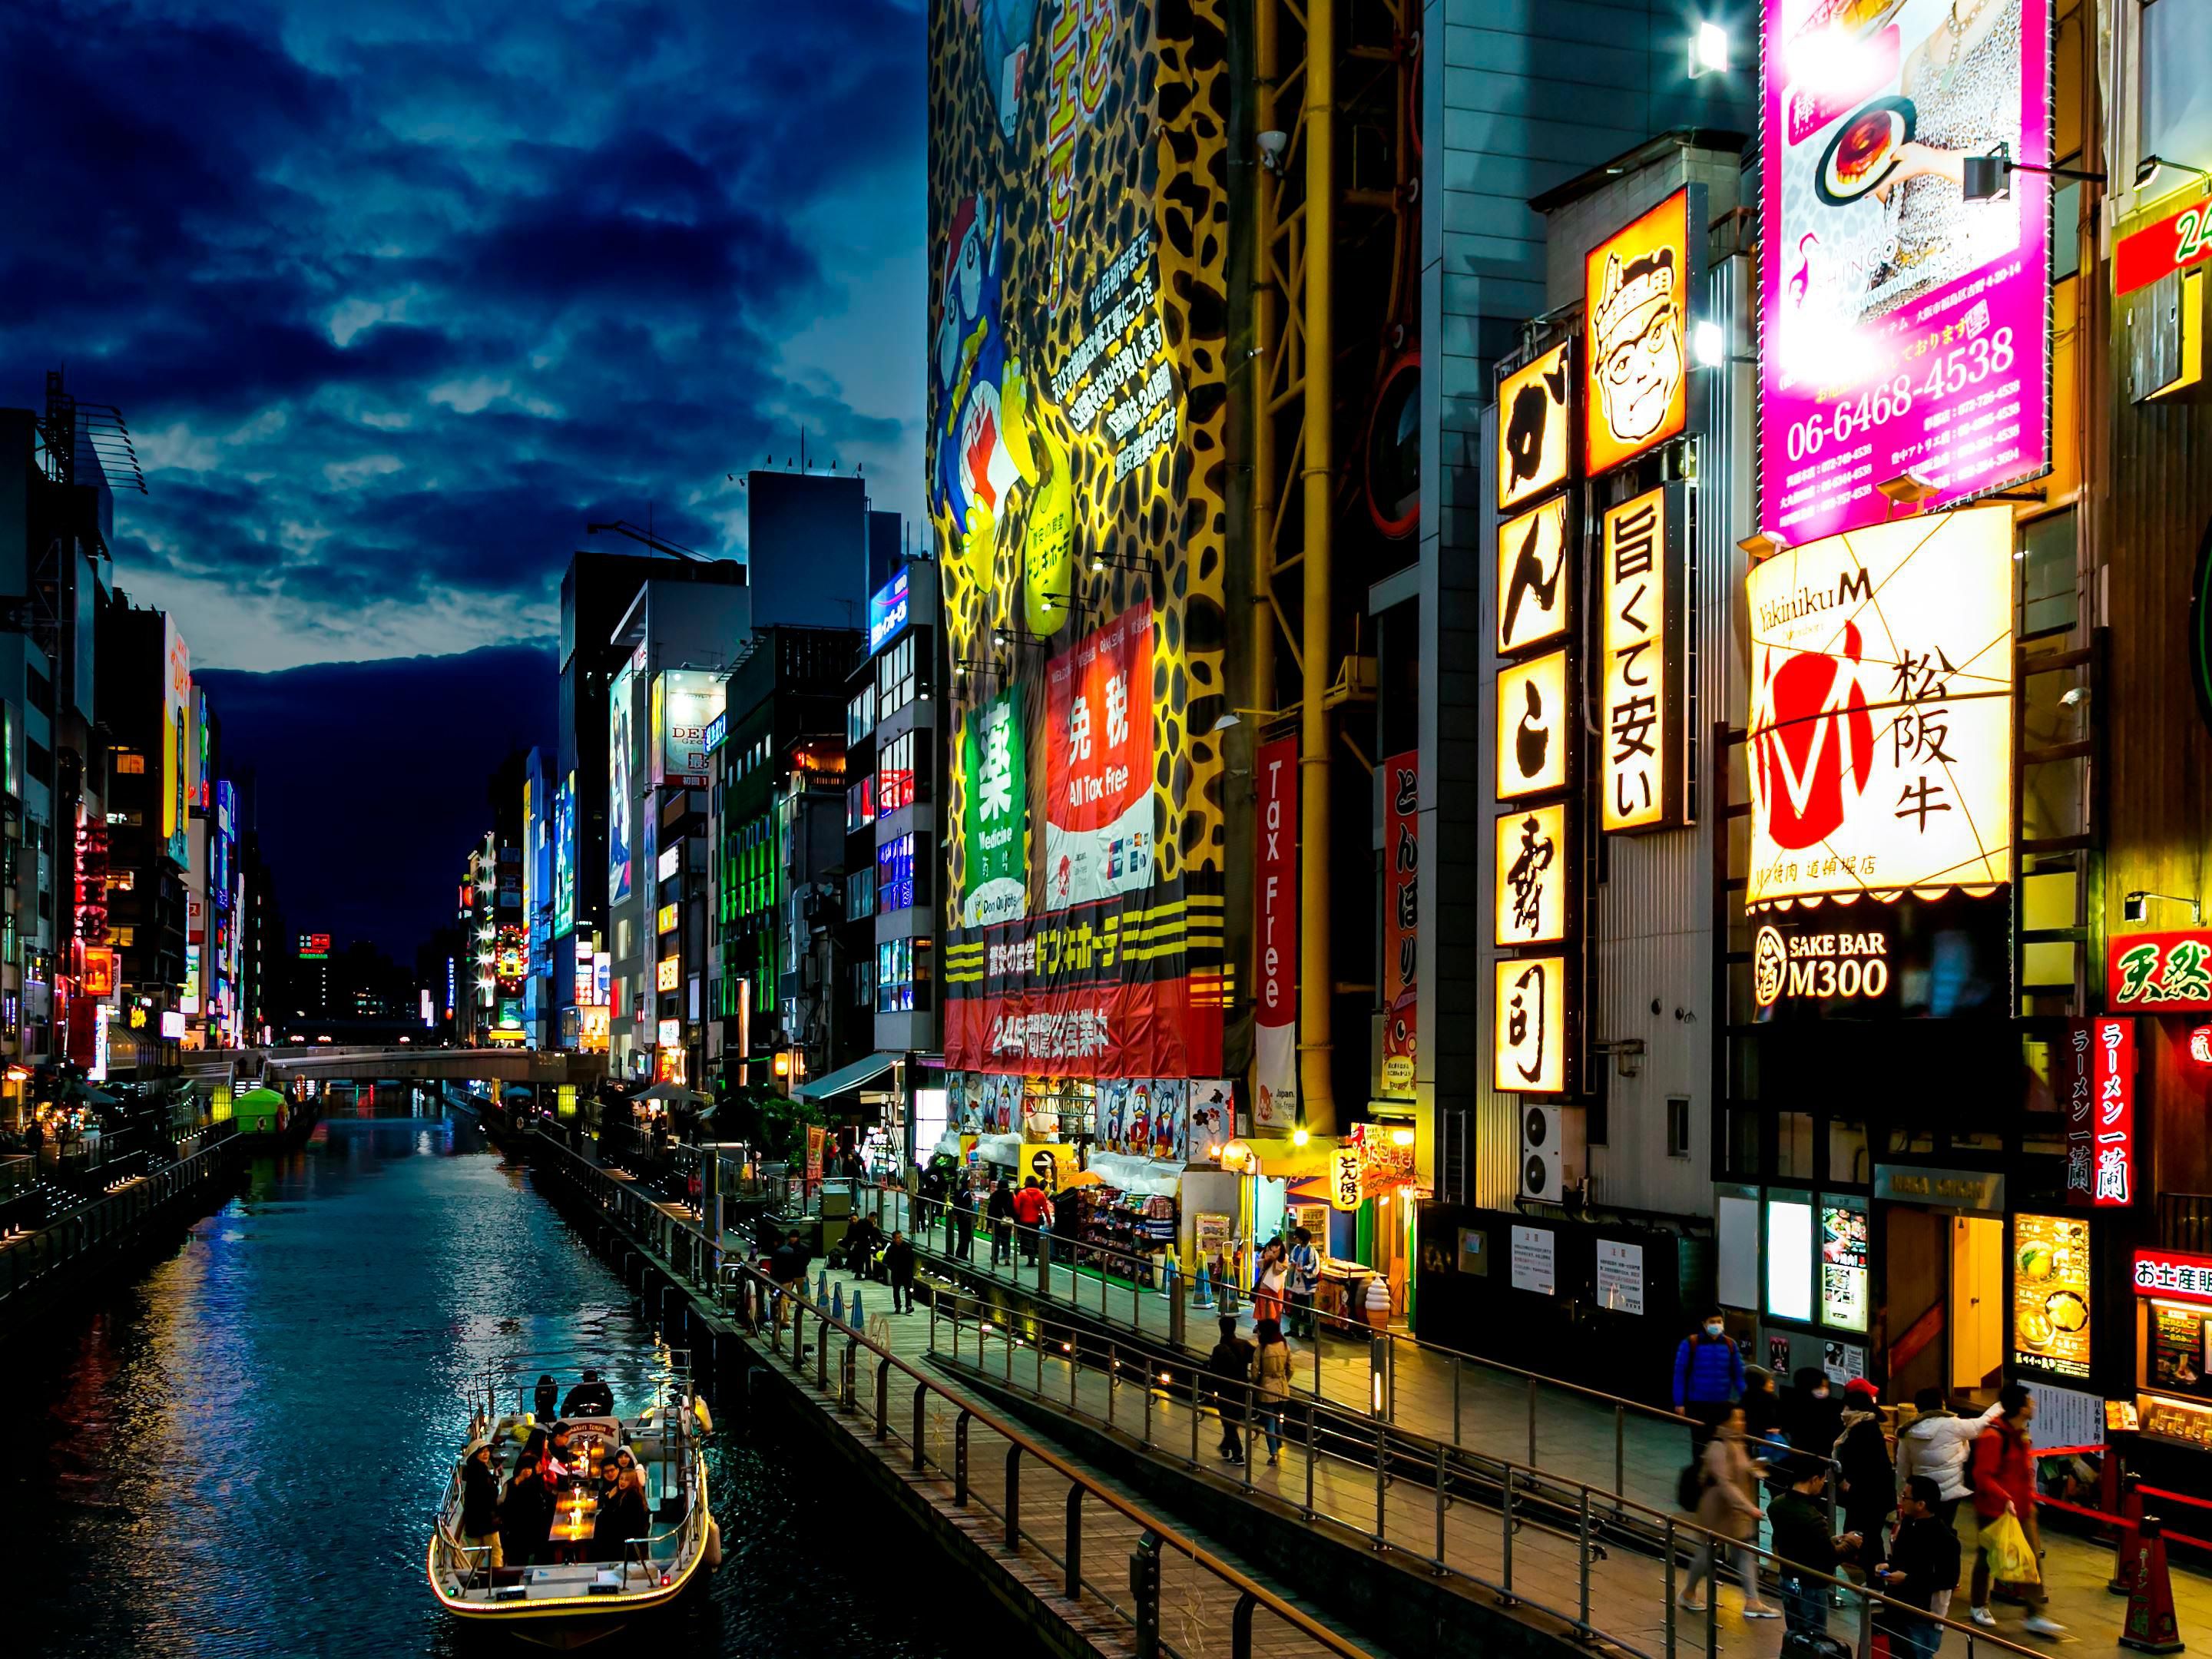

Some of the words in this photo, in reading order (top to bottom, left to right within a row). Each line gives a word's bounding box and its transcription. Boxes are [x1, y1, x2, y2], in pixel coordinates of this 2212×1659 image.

[1089, 228, 1150, 314] 12月初旬まで
[1787, 326, 2014, 462] 06-6468-4538
[1760, 586, 1834, 633] Yakiniku
[1611, 503, 1657, 818] 旨くて安い
[1068, 669, 1128, 767] 免税
[1889, 644, 1958, 835] 松阪牛
[1069, 777, 1082, 808] All
[1084, 774, 1103, 801] Tax
[1104, 763, 1129, 794] Free
[1266, 760, 1283, 861] Tax
[978, 826, 1012, 850] Medicine
[1806, 855, 1877, 879] 道頓堀店
[1265, 876, 1280, 1008] Free
[1786, 959, 1888, 998] M300
[1789, 934, 1836, 958] SAKE
[1839, 932, 1887, 956] BAR
[2115, 939, 2212, 1004] 天然
